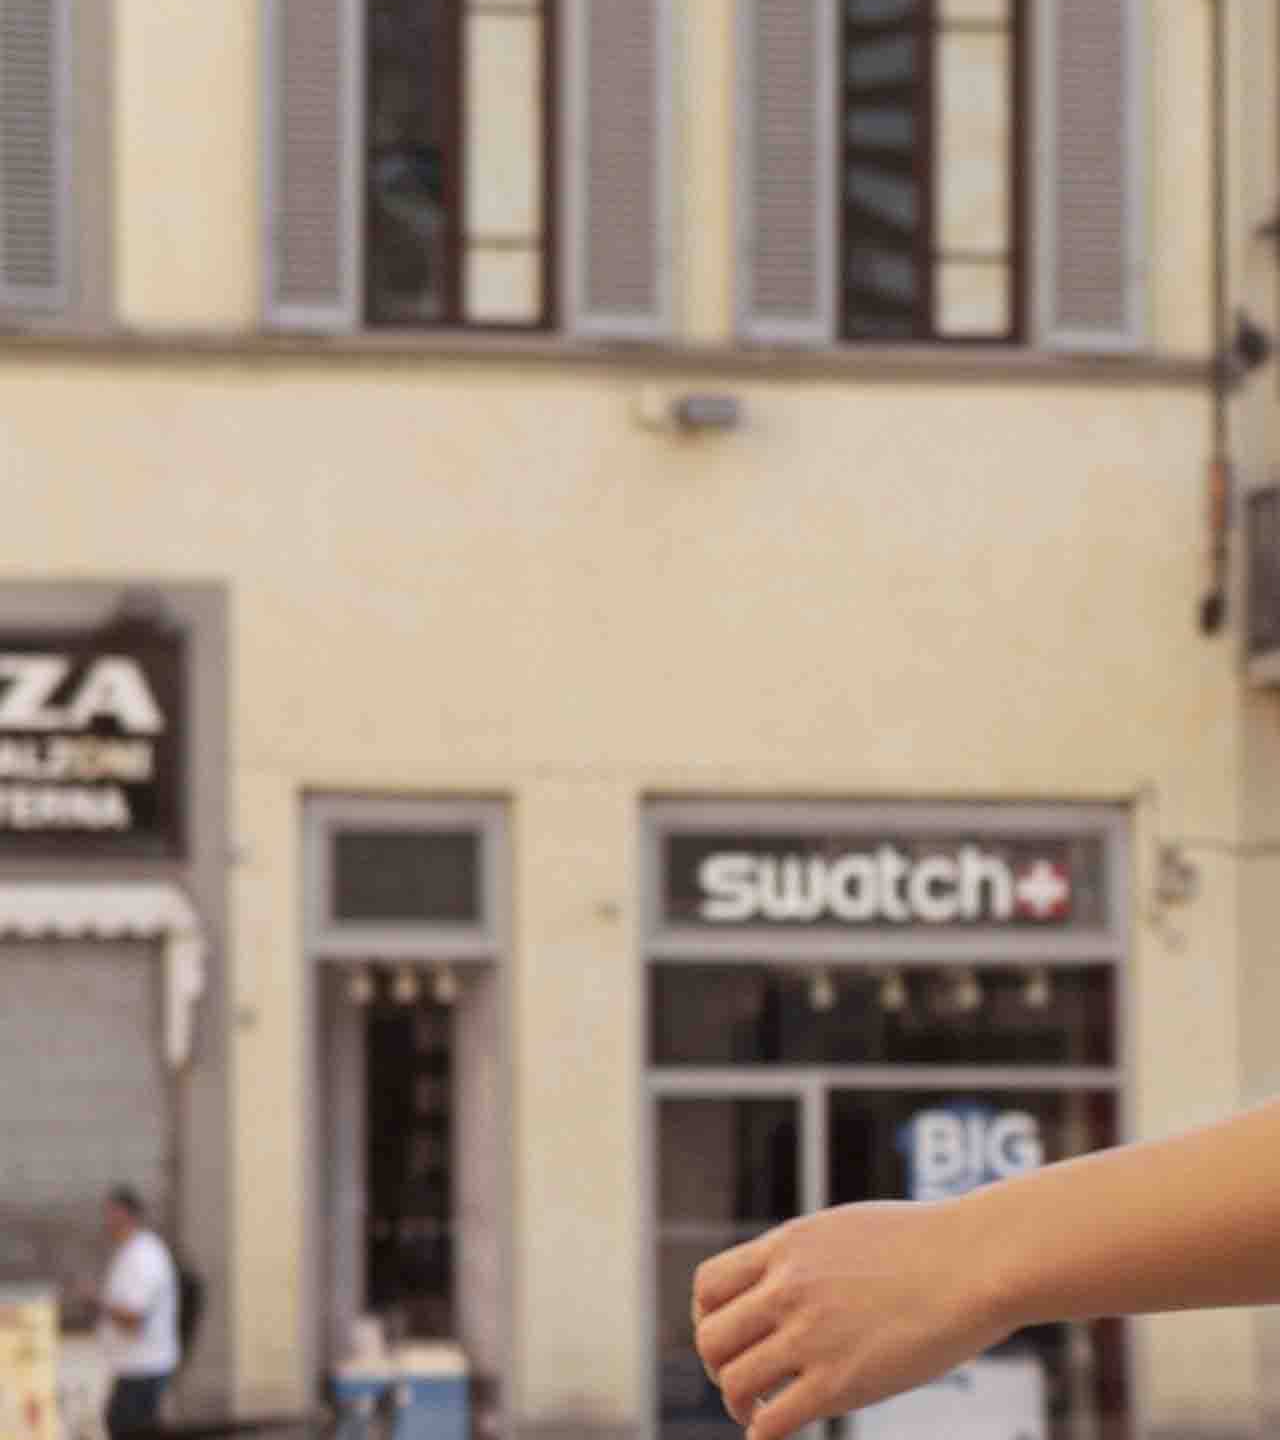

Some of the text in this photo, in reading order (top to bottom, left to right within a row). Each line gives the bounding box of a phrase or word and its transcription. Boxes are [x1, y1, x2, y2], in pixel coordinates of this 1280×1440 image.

[0, 654, 166, 733] ZA
[699, 845, 1014, 921] swatch
[911, 1109, 1045, 1177] BIG
